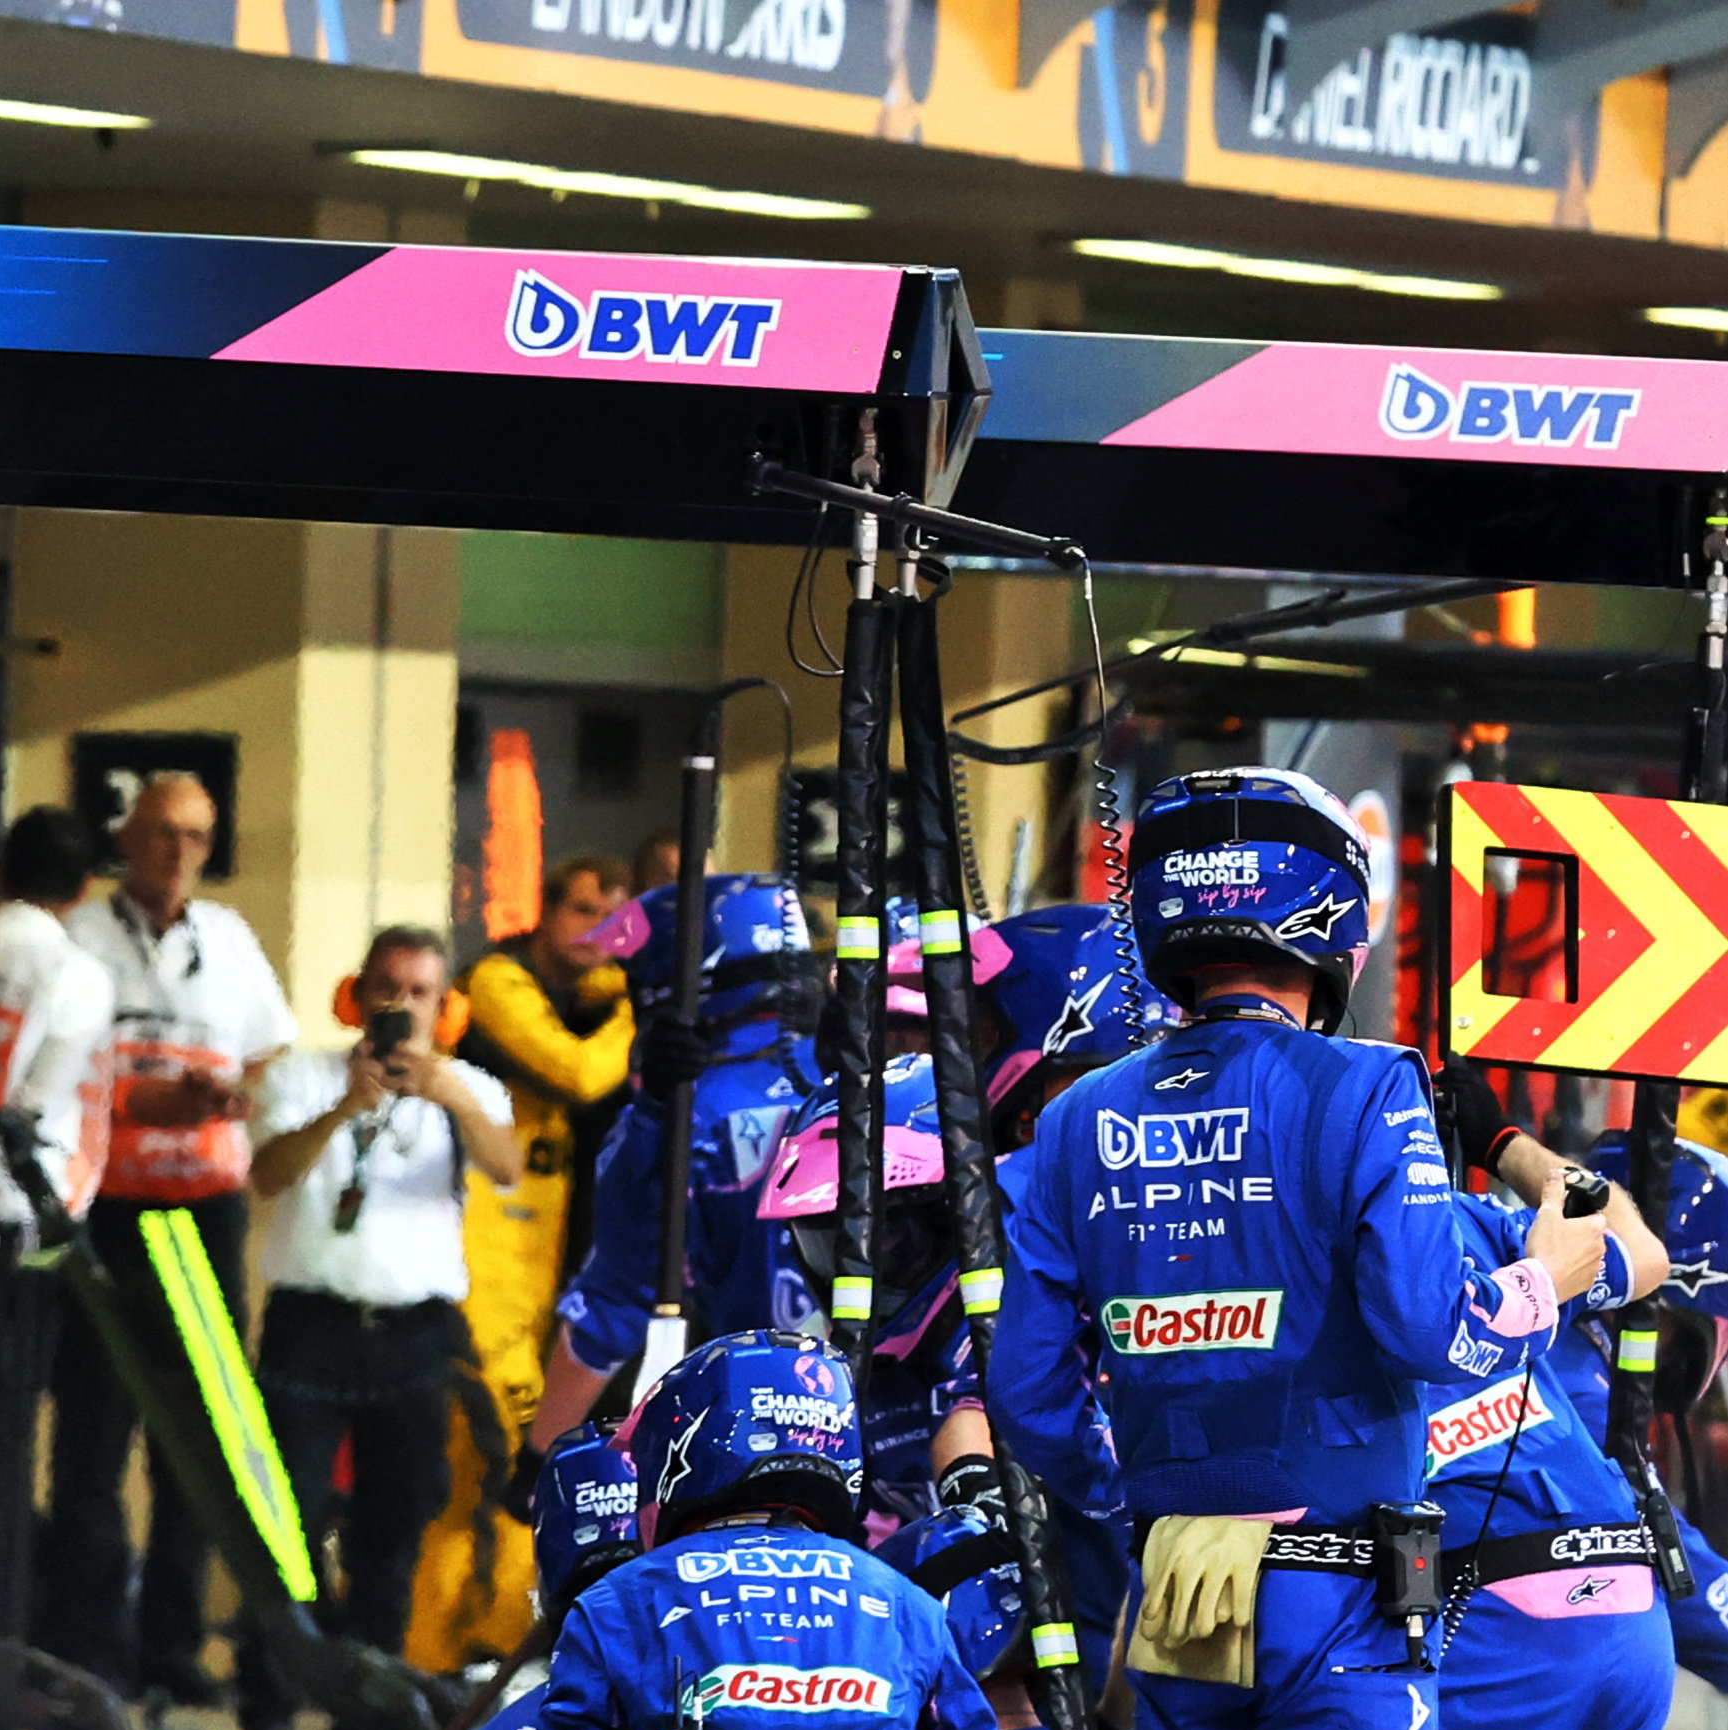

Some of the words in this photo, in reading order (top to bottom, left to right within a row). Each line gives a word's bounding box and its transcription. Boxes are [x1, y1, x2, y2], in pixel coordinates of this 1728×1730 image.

[583, 293, 778, 363] BWT
[1454, 385, 1637, 445] BWT
[1162, 875, 1180, 883] THE
[1180, 868, 1259, 887] WORLD
[1164, 851, 1259, 874] CHANGE
[1198, 888, 1218, 908] sip
[1222, 884, 1240, 908] by
[1244, 885, 1267, 904] sip
[1137, 1108, 1249, 1167] BWT
[1088, 1177, 1274, 1221] ALPINE
[1165, 1218, 1226, 1241] TEAM
[1134, 1297, 1267, 1347] Castrol
[751, 1395, 839, 1417] CHANGE
[773, 1408, 842, 1434] WORLD
[1429, 1382, 1542, 1456] Castrol
[576, 1482, 638, 1503] CHAN
[1265, 1533, 1375, 1565] nestars
[1549, 1526, 1655, 1562] alpinest
[732, 1548, 852, 1580] BWT
[659, 1584, 891, 1628] ALPINE
[761, 1611, 835, 1629] TEAM
[728, 1669, 879, 1707] Castrol
